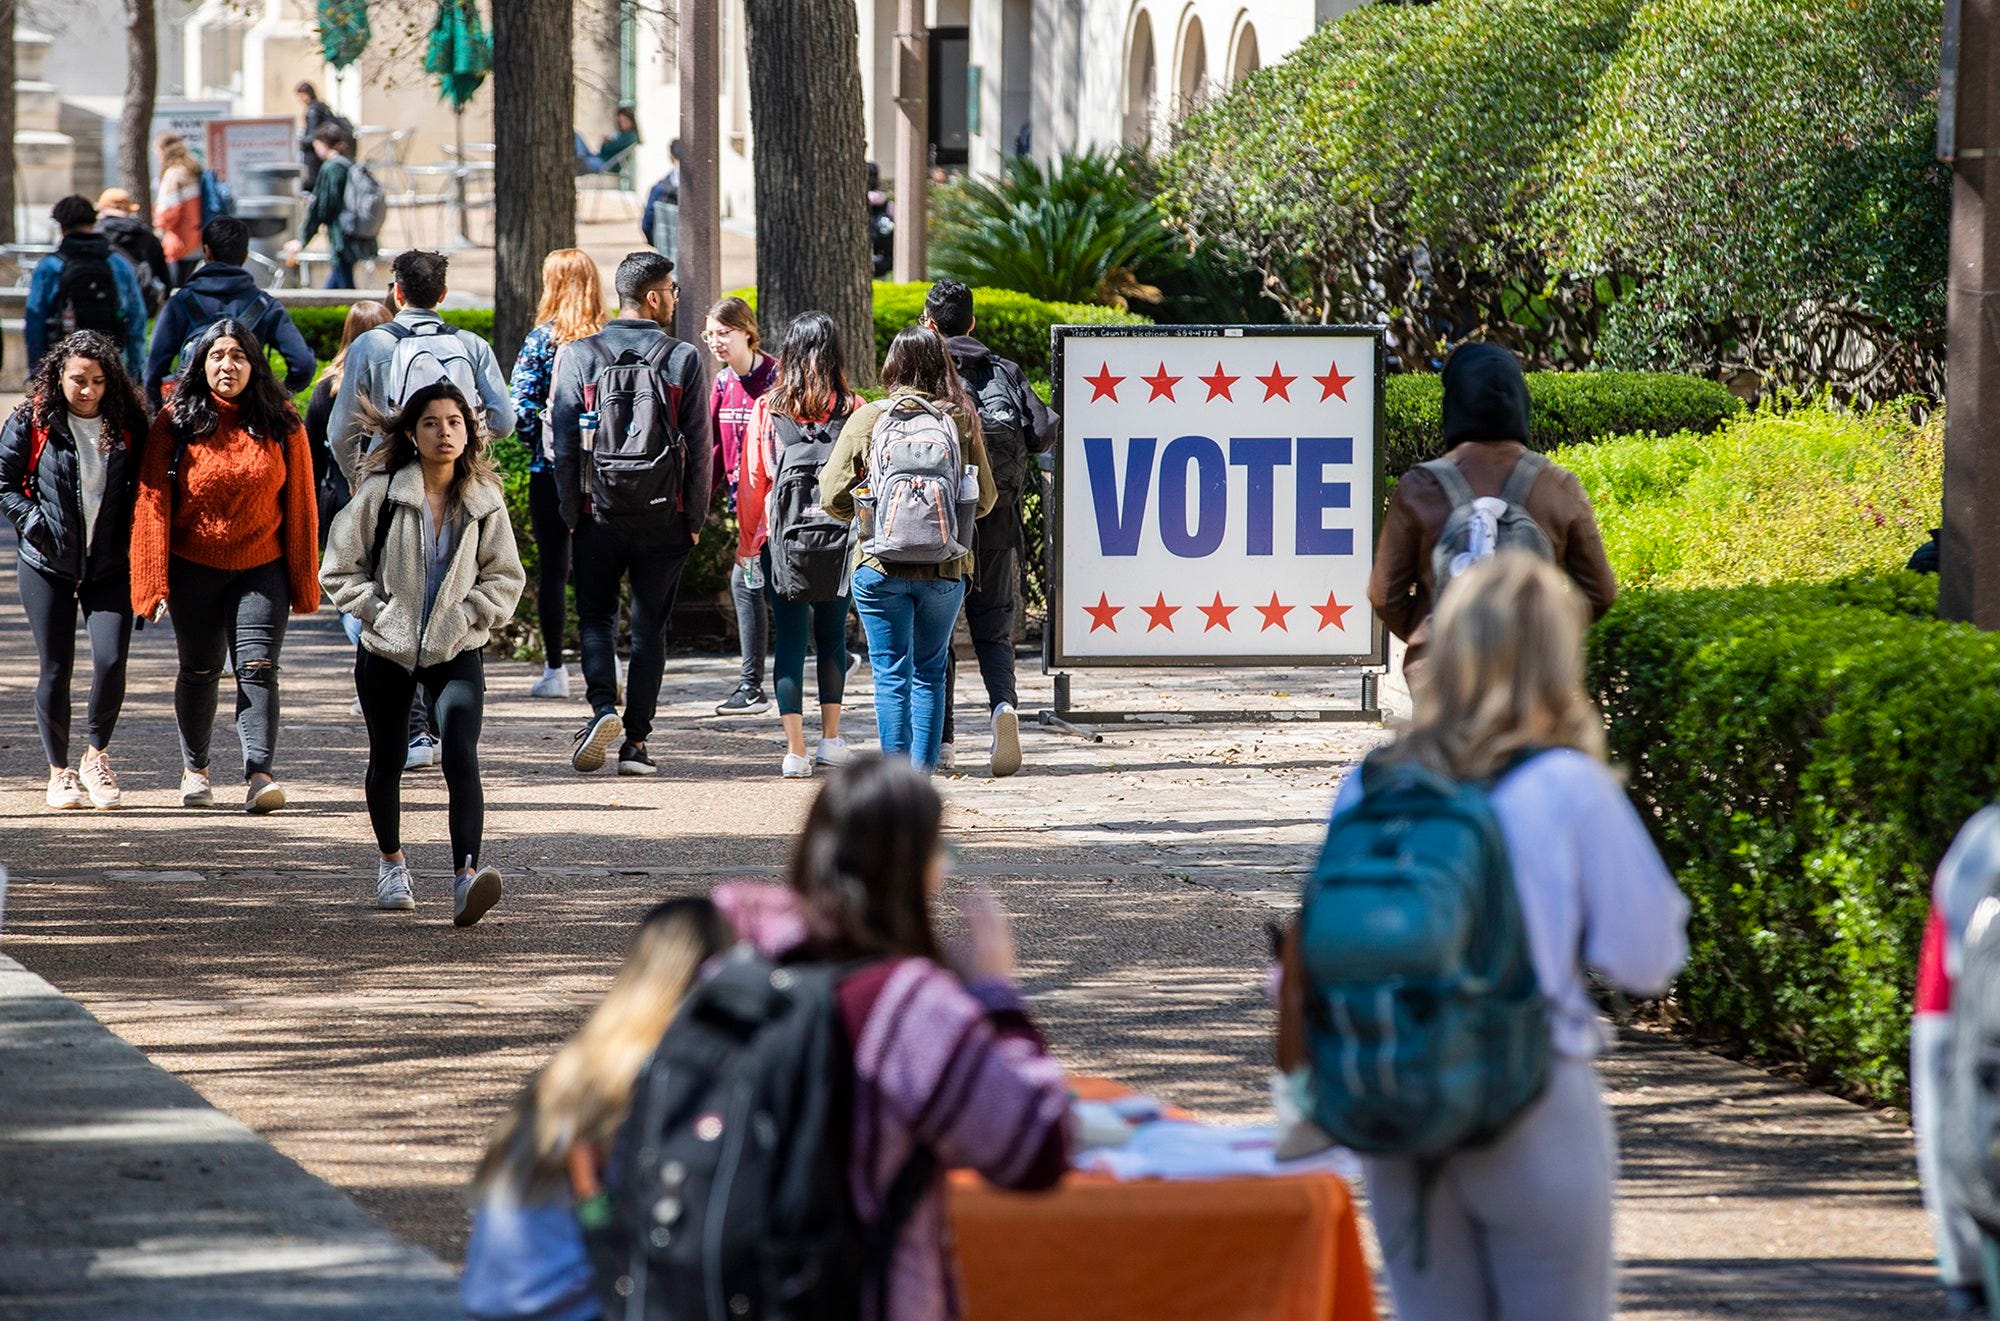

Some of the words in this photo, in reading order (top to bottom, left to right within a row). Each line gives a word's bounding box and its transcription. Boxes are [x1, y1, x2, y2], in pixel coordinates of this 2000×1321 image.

[1071, 327, 1096, 337] Travis
[1101, 329, 1129, 337] County
[1132, 329, 1169, 337] Elections
[1083, 435, 1354, 558] VOTE
